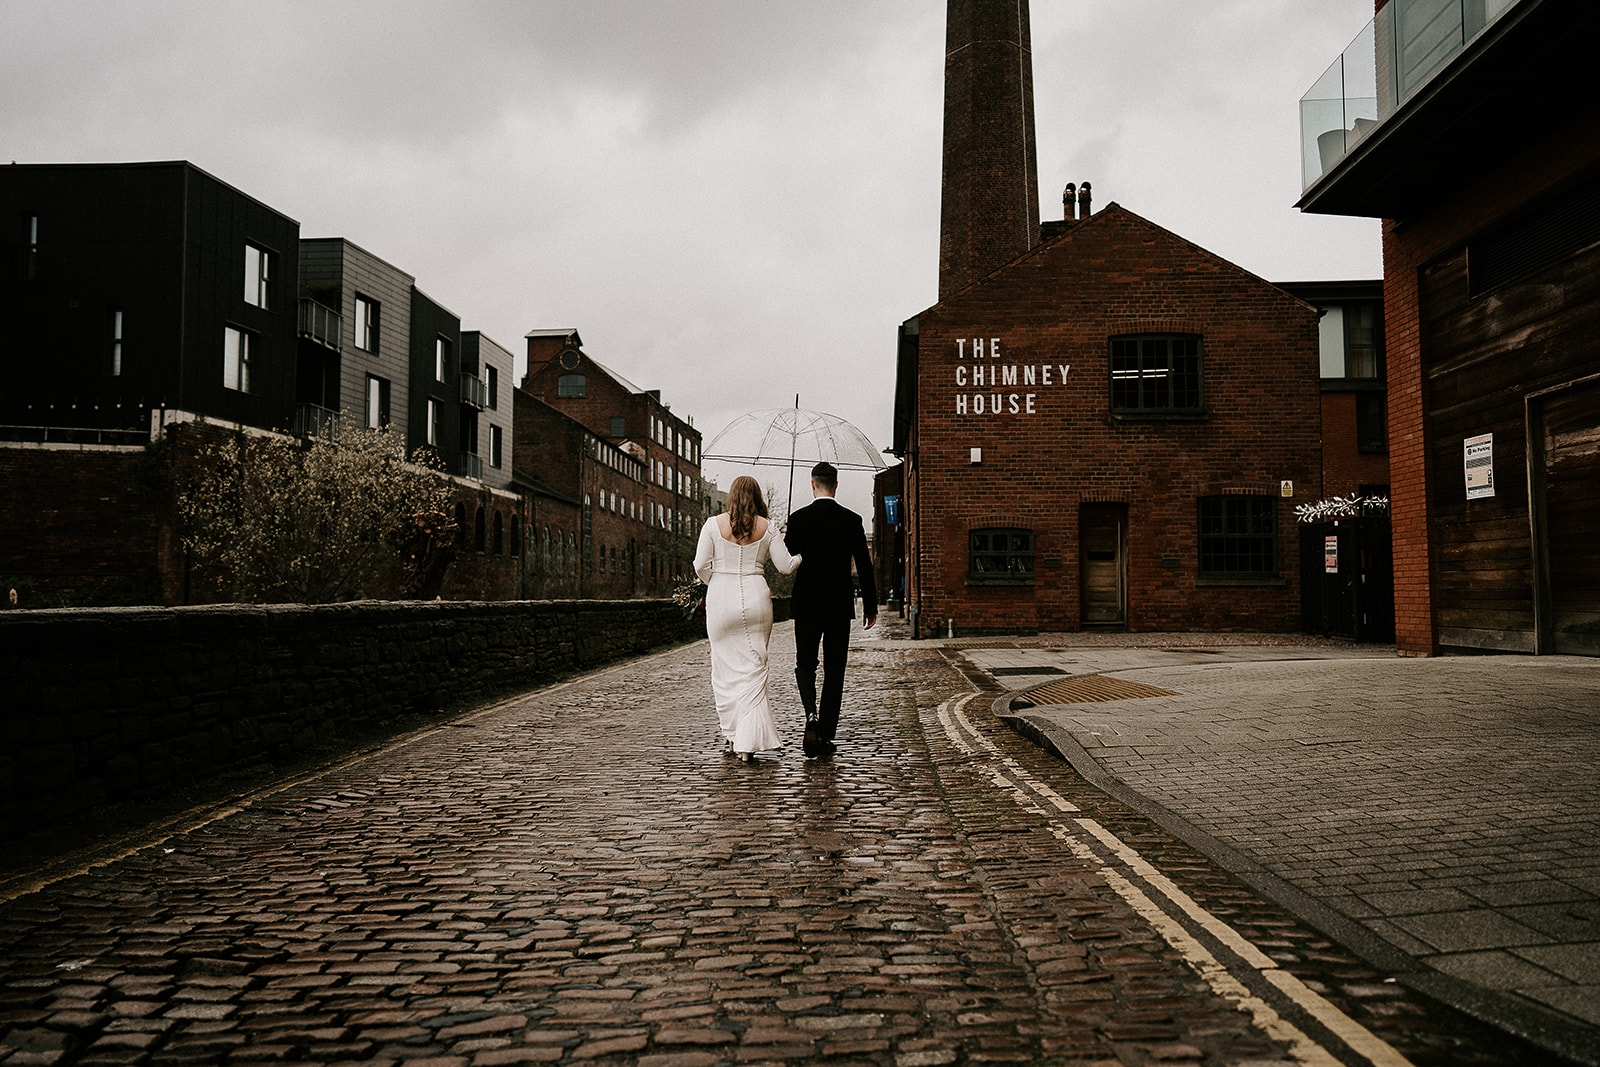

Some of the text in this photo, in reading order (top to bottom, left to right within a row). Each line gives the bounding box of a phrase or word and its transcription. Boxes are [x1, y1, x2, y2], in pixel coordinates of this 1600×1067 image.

[956, 338, 1001, 358] THE
[956, 365, 1070, 386] CHIMNEY
[956, 393, 1036, 414] HOUSE
